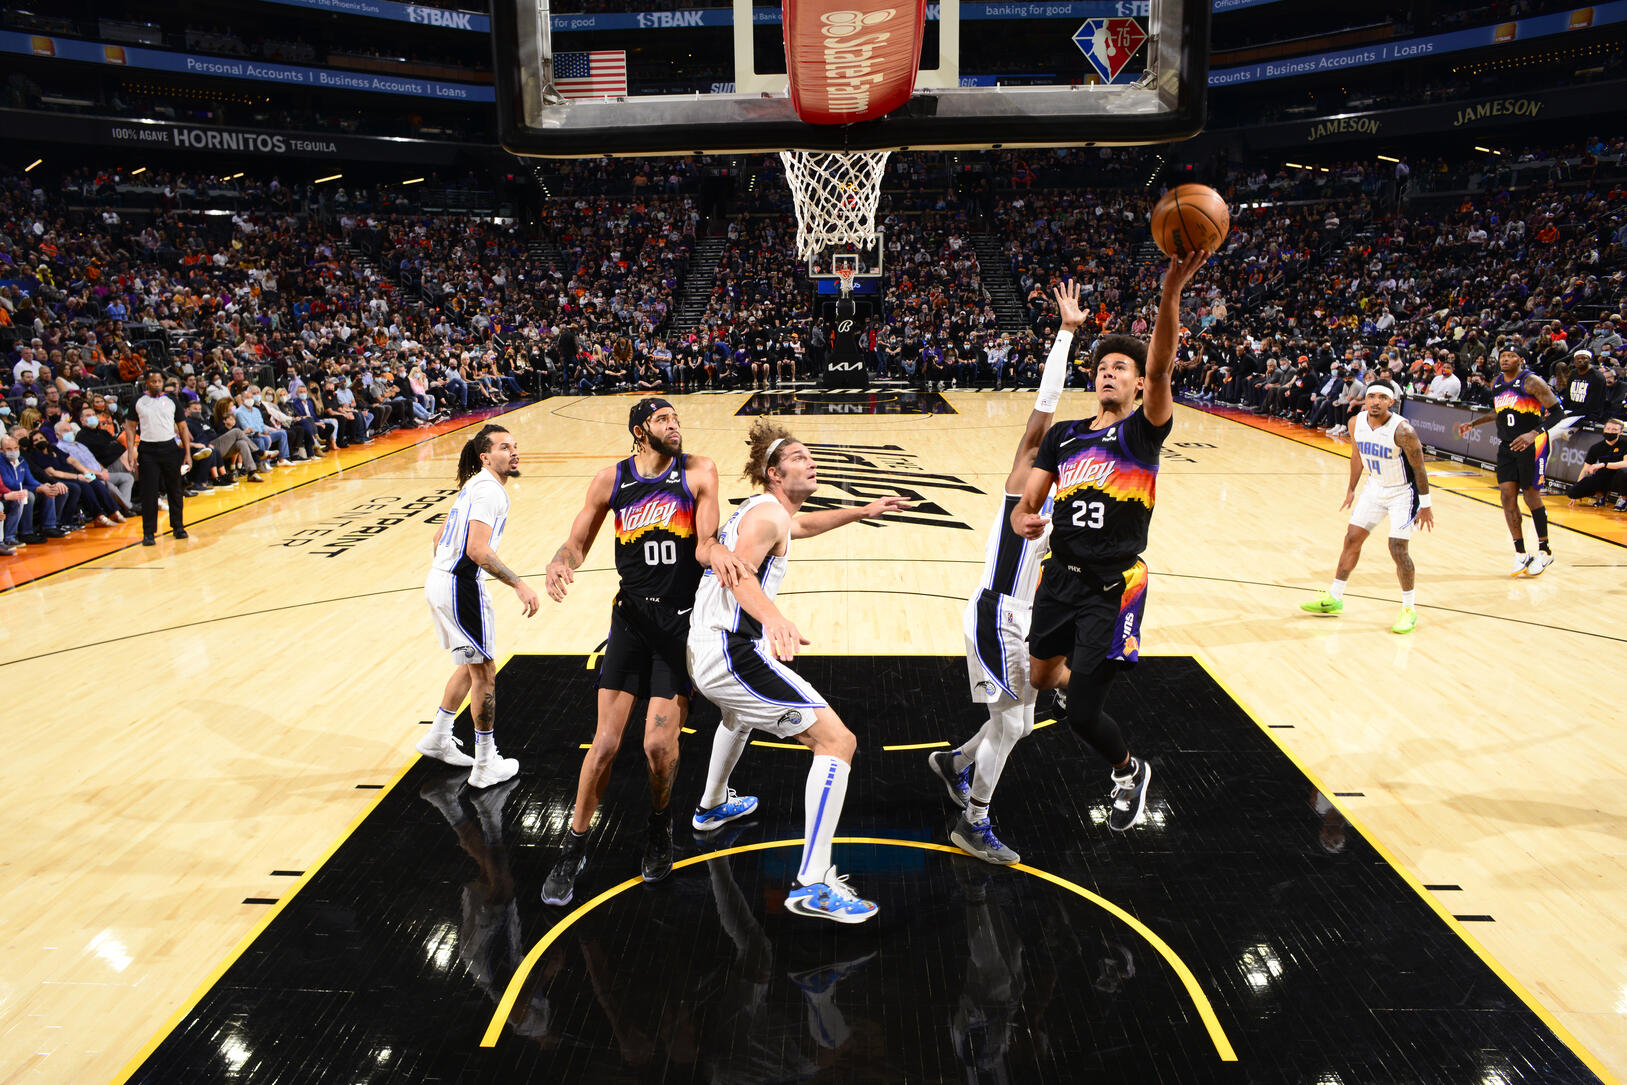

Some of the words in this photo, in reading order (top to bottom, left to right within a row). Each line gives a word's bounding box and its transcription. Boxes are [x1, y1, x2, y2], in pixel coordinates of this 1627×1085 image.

[361, 3, 380, 13] Suns
[406, 5, 472, 30] 1STBANK
[759, 12, 777, 21] Bank
[985, 5, 1027, 18] banking
[1029, 5, 1044, 15] for
[1046, 4, 1072, 17] good
[1115, 1, 1149, 17] 1STB
[554, 19, 569, 28] for
[570, 16, 596, 30] good
[636, 10, 704, 29] 1STBANK
[1116, 28, 1131, 47] 75
[1207, 70, 1251, 85] ccounts
[1266, 62, 1316, 77] Business
[1318, 50, 1376, 69] Accounts
[1394, 42, 1434, 57] Loans
[187, 58, 243, 75] Personal
[246, 65, 304, 81] Accounts
[320, 72, 370, 88] Business
[372, 79, 423, 93] Accounts
[436, 85, 467, 97] Loans
[960, 78, 978, 88] GIC
[709, 82, 736, 94] SUN
[1453, 99, 1543, 126] JAMESON
[1307, 117, 1381, 141] JAMESON
[112, 128, 138, 140] 100%
[139, 130, 169, 142] AGAVE
[173, 128, 286, 152] HORNITOS
[289, 140, 337, 152] TEQUILA
[1506, 413, 1516, 427] 0
[1356, 441, 1393, 460] MAGIC
[1561, 447, 1585, 466] aps
[1057, 457, 1116, 490] Valley
[1366, 458, 1381, 475] 14
[268, 496, 402, 548] CENTER
[620, 500, 677, 532] Valley
[1072, 501, 1105, 529] 23
[643, 540, 677, 566] 00
[1067, 565, 1081, 573] PHX
